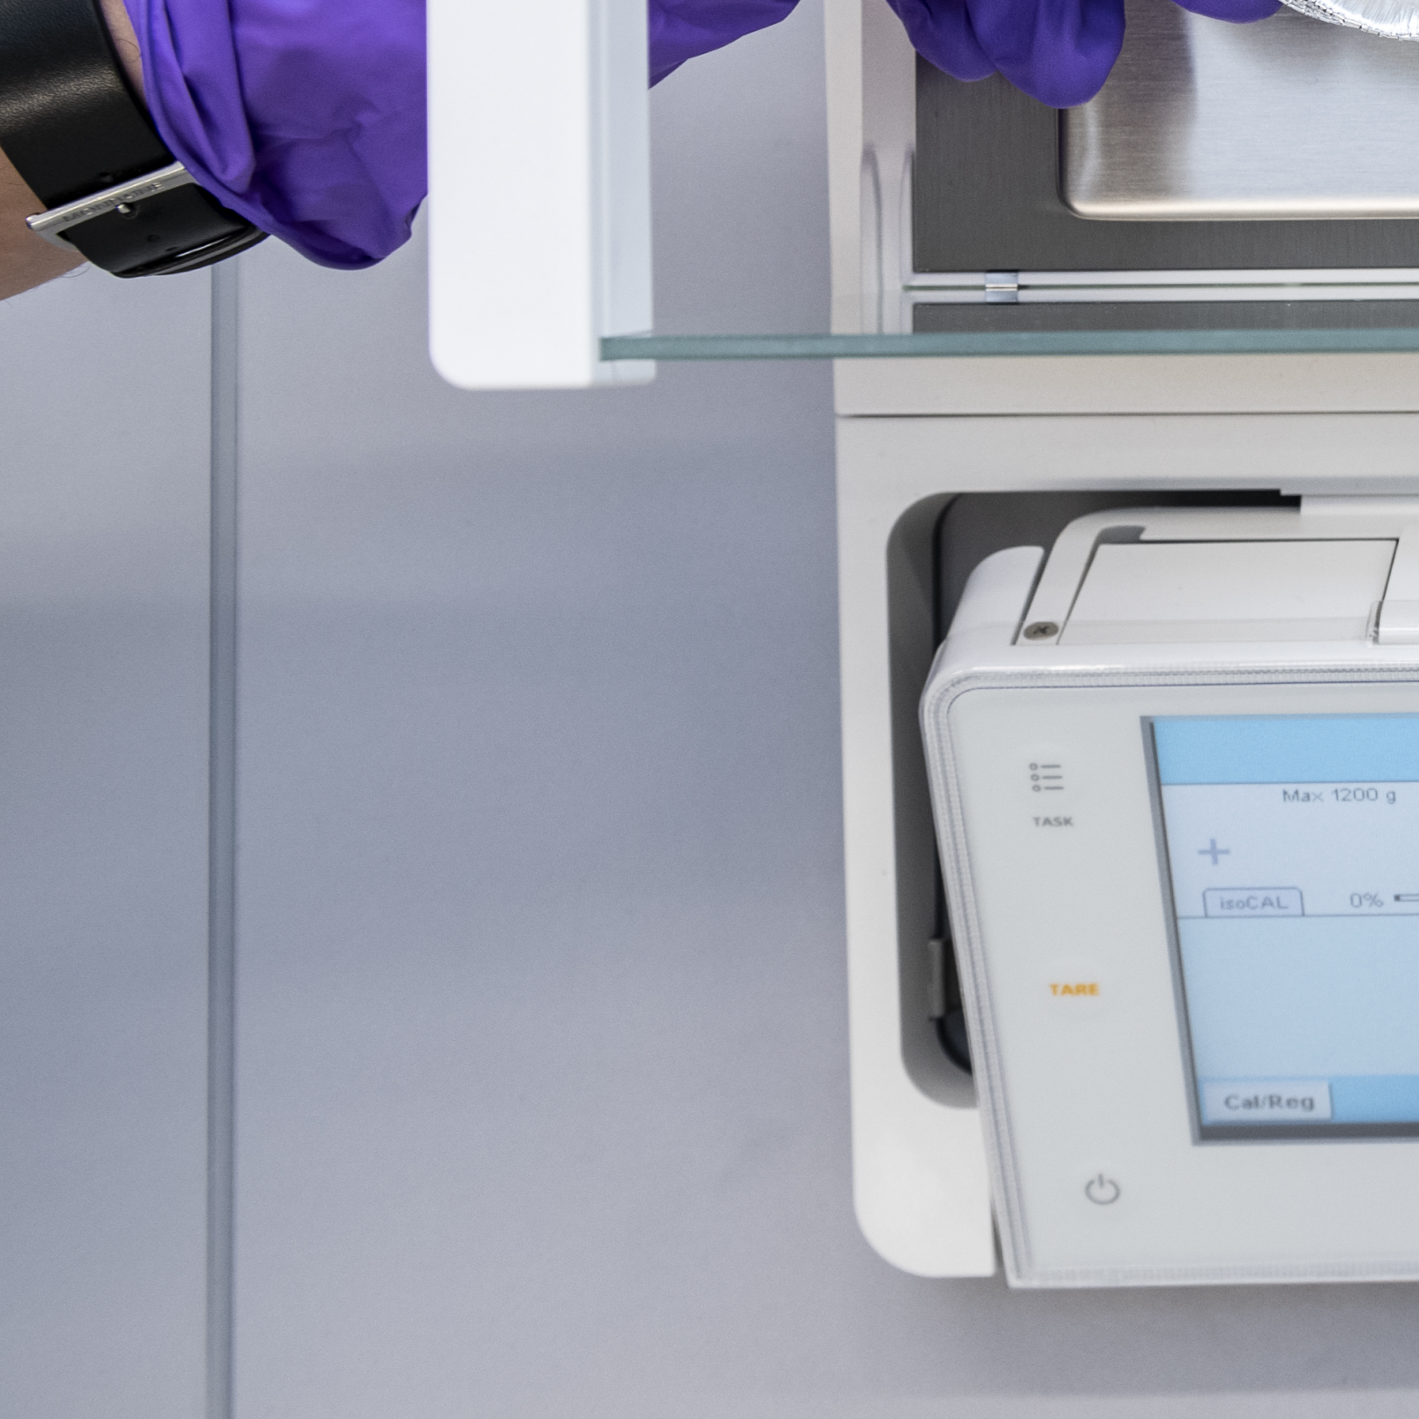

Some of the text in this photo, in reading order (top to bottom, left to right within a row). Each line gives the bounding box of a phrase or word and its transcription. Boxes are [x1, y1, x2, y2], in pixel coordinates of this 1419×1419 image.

[1282, 788, 1396, 803] Max 1200 g
[1033, 816, 1074, 828] TASK
[1219, 895, 1289, 912] isoCAL
[1349, 893, 1384, 909] 0%
[1049, 984, 1100, 997] TARE
[1223, 1093, 1316, 1111] Cal/Reg
